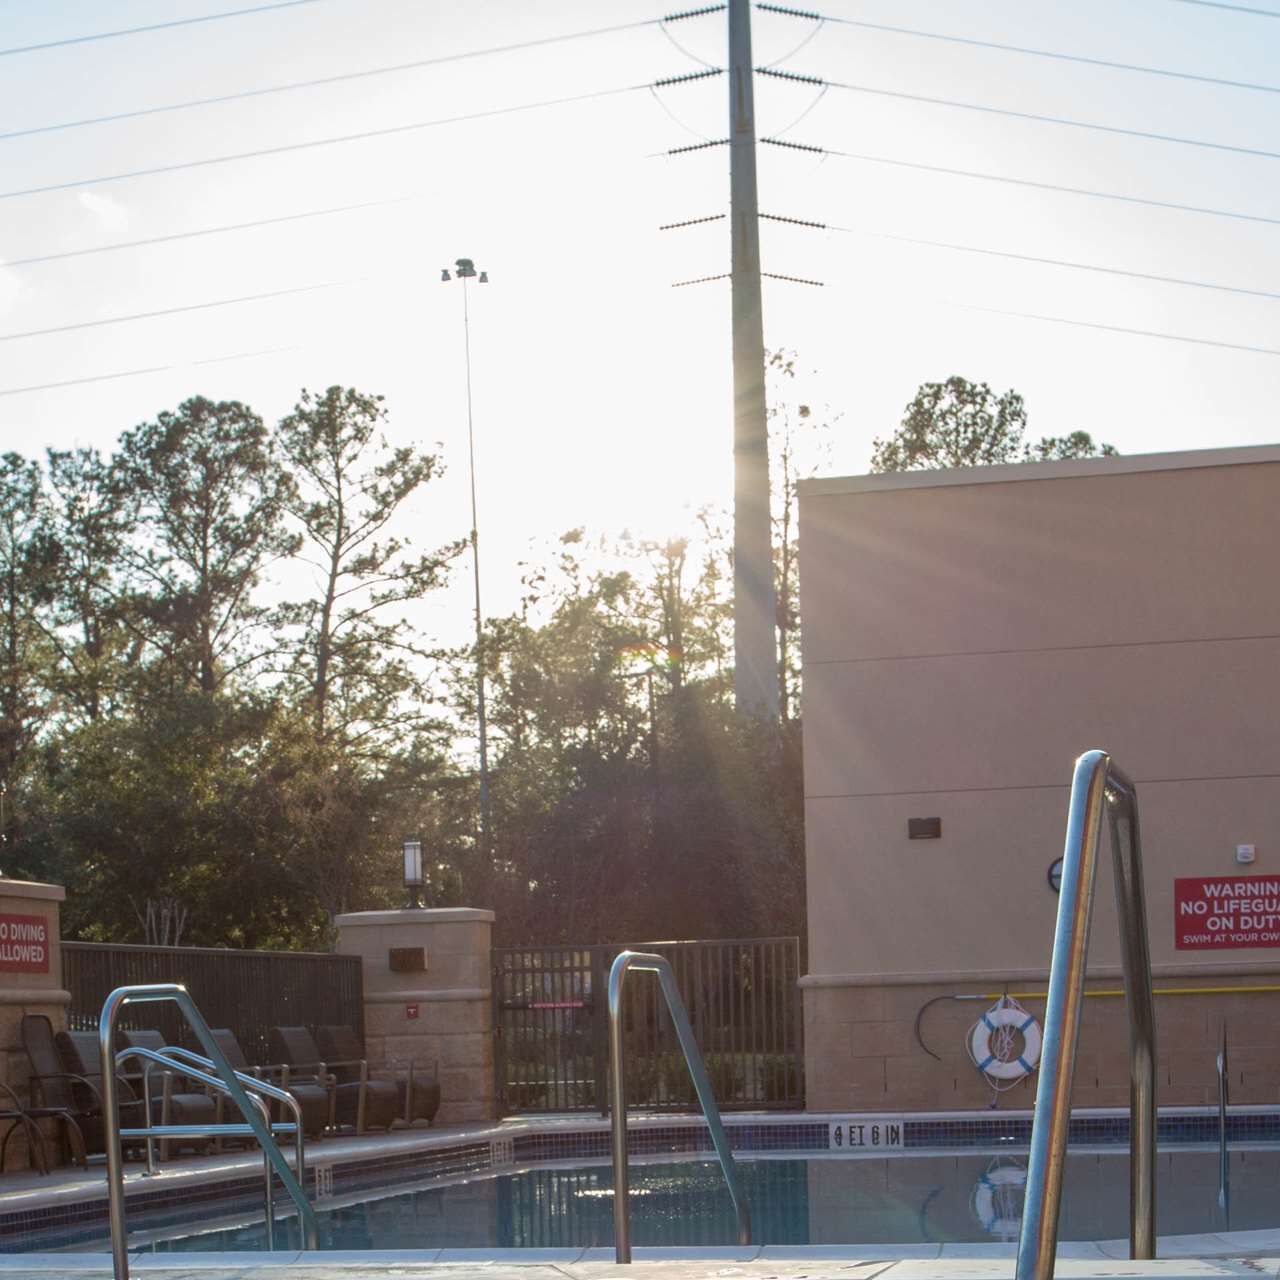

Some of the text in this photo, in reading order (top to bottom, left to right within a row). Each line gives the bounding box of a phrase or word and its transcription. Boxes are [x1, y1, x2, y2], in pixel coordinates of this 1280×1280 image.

[1180, 900, 1208, 915] NO
[1206, 915, 1235, 931] ON
[10, 923, 46, 942] DIVING
[1183, 934, 1212, 944] SWIM
[1214, 933, 1228, 943] AT
[1230, 932, 1259, 942] YOUR
